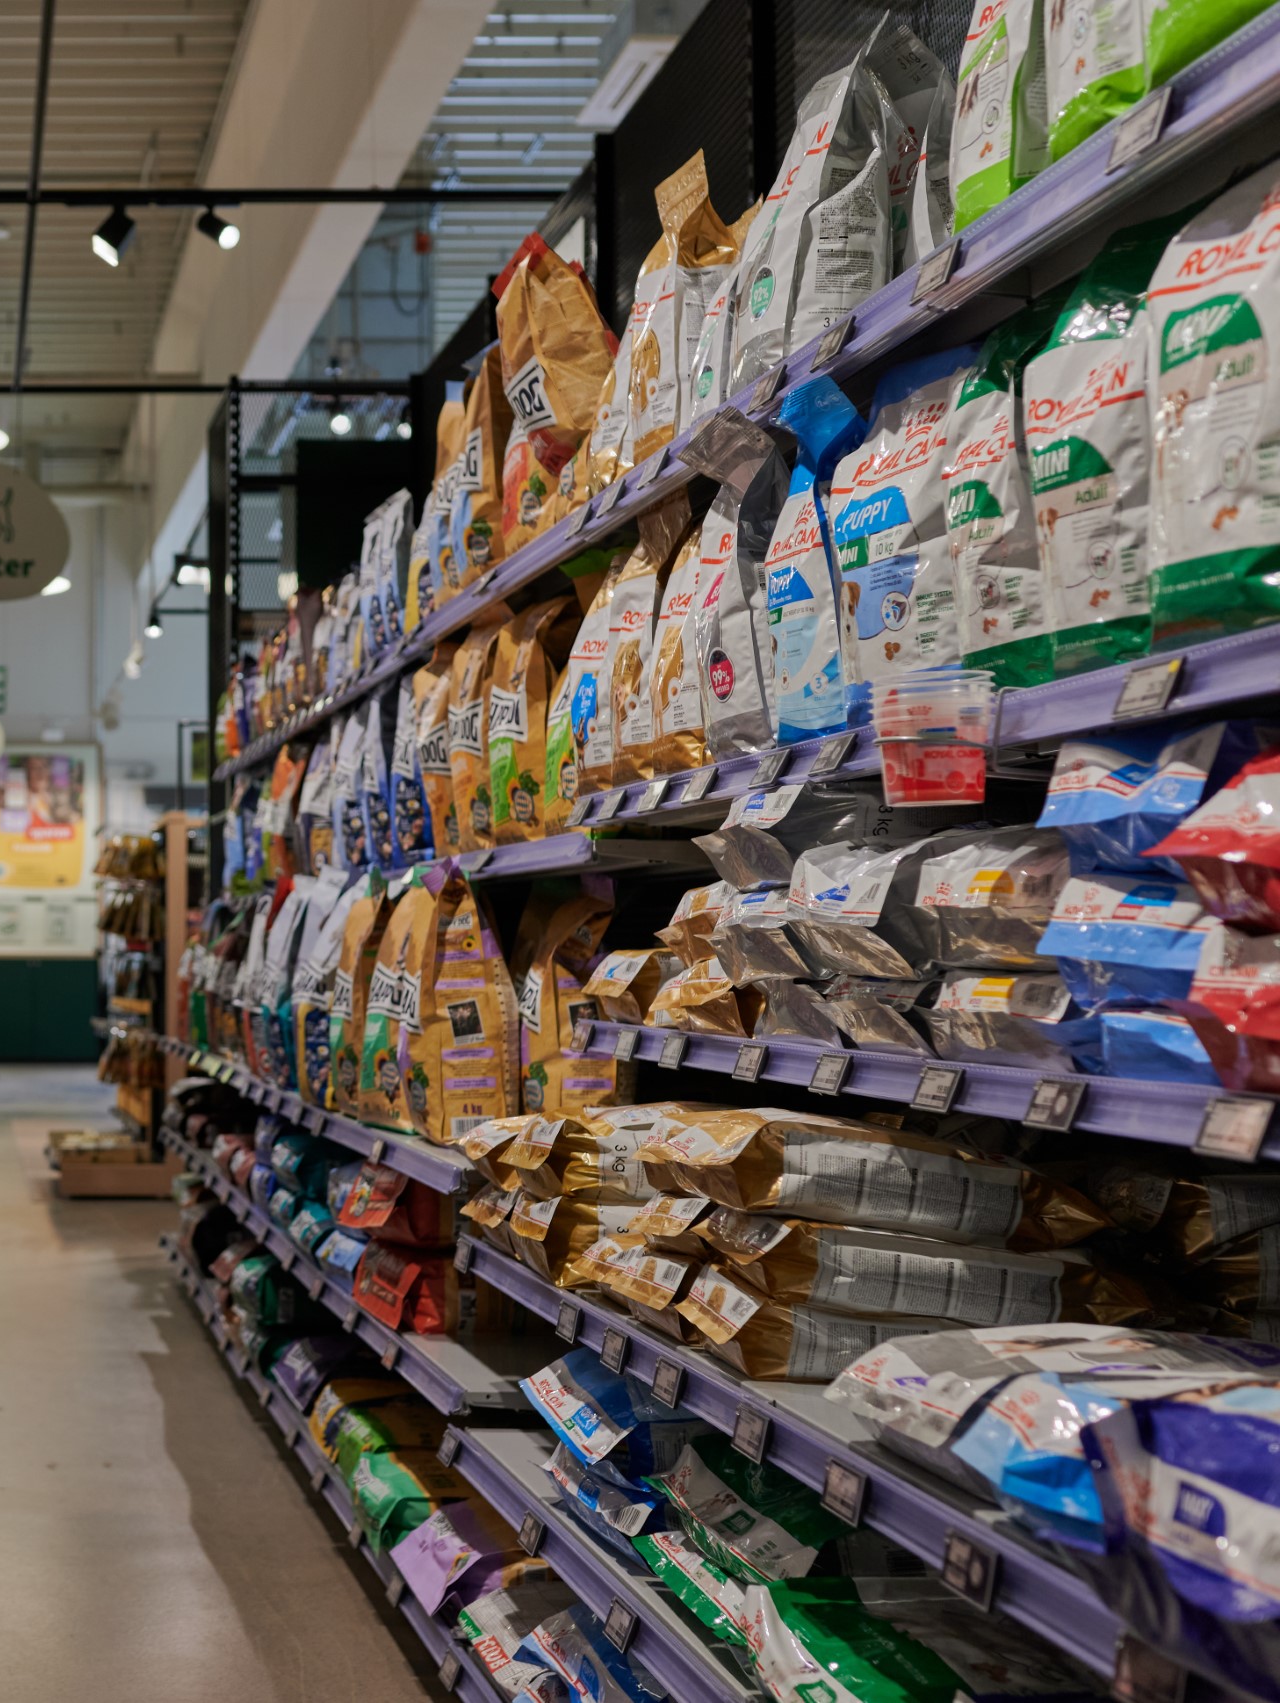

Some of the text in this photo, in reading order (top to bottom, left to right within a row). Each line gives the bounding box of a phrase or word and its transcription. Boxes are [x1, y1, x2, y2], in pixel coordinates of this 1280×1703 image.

[852, 449, 906, 482] RYAL
[842, 497, 892, 533] PUPPY
[876, 543, 894, 556] 10 kg
[581, 640, 608, 653] ROYA
[712, 669, 730, 686] 99%
[815, 677, 822, 689] 3
[421, 735, 445, 764] DOG
[470, 1102, 482, 1117] kg
[612, 1144, 627, 1172] 3 kg
[617, 1226, 629, 1234] 3
[477, 1638, 509, 1672] CLUB
